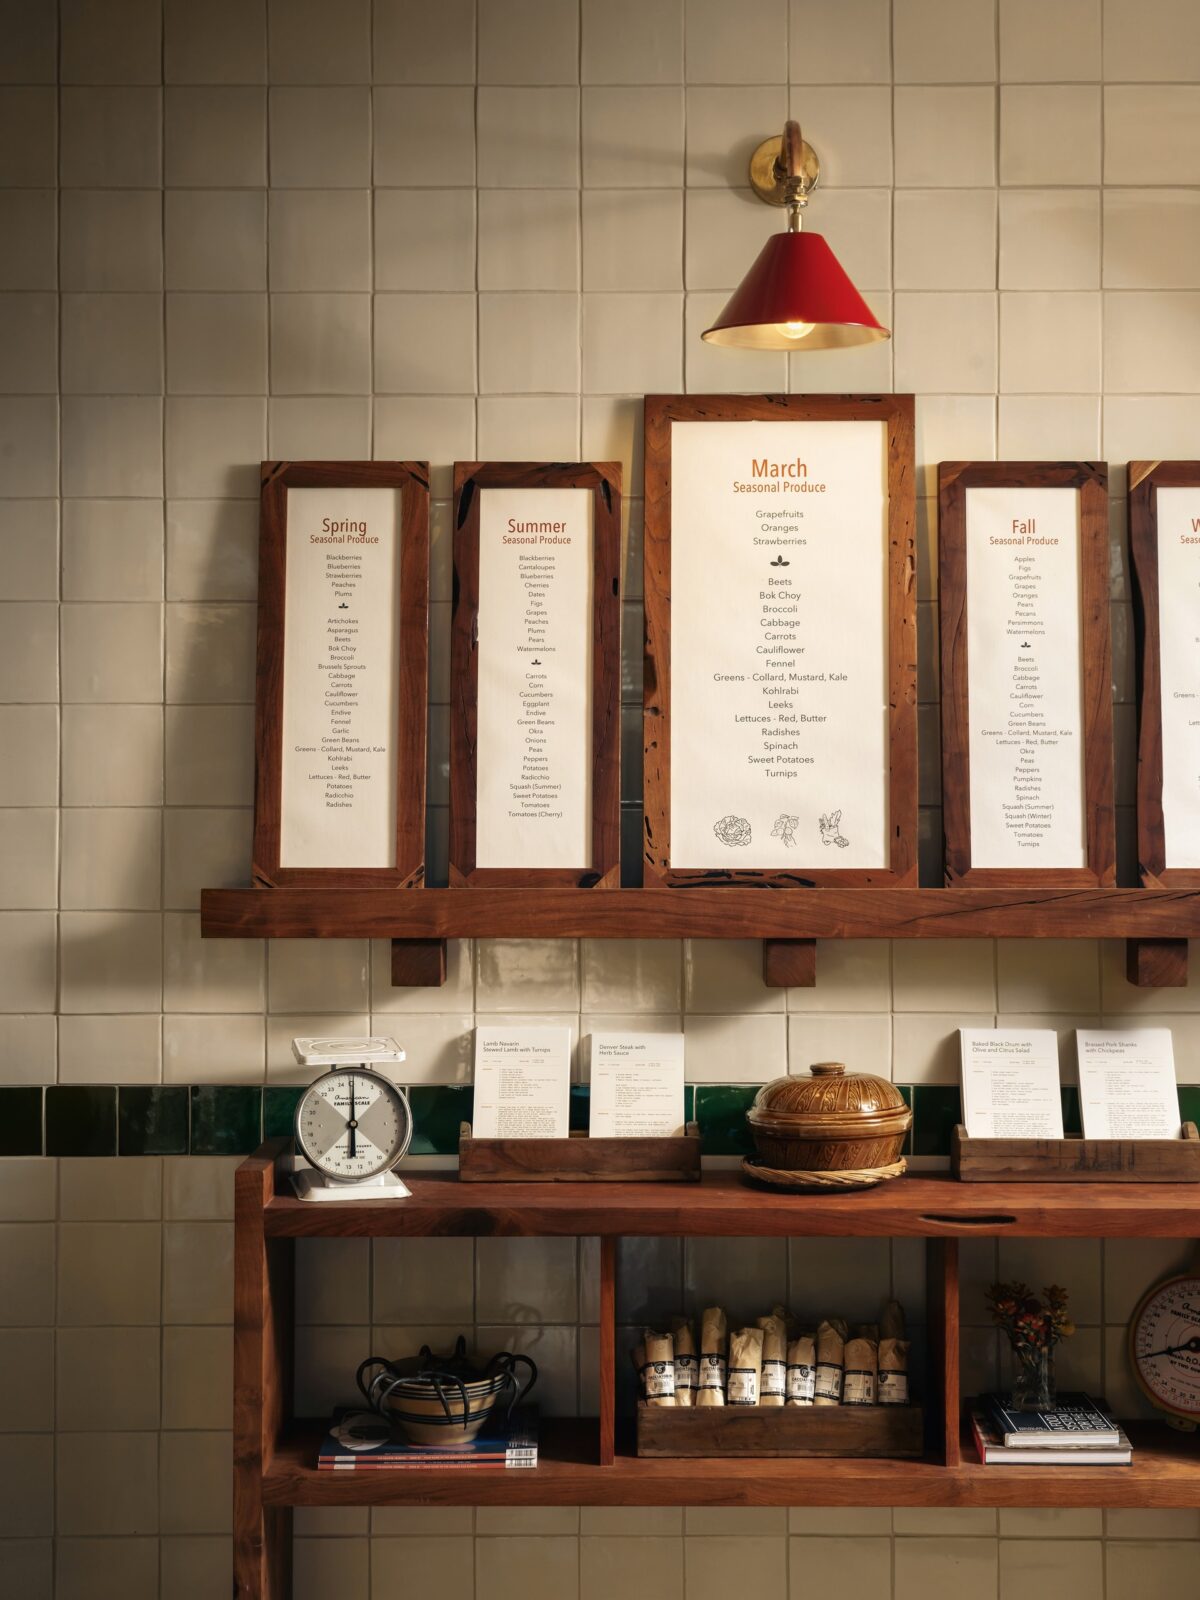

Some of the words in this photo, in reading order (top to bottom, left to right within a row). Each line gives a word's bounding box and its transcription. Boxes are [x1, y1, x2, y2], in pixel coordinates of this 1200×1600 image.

[752, 458, 807, 478] March
[733, 481, 780, 493] Seasonal
[783, 481, 826, 493] Produce
[755, 509, 804, 520] Grapefruits
[322, 517, 367, 537] Spring
[508, 518, 567, 533] Summer
[761, 523, 799, 534] Oranges
[1012, 519, 1035, 534] Fall
[310, 534, 345, 544] Seasonal
[347, 534, 379, 544] Produce
[502, 535, 537, 544] Seasonal
[539, 535, 571, 544] Produce
[753, 537, 807, 545] Strawberries
[990, 536, 1025, 545] Seasonal
[1027, 536, 1059, 545] Produce
[768, 577, 792, 586] Beets
[759, 591, 776, 600] Bok
[778, 591, 801, 601] Choy
[762, 605, 798, 613] Broccoli
[760, 618, 801, 629] Cabbage
[764, 632, 797, 641] Carrots
[755, 645, 805, 654] Cauliflower
[766, 659, 795, 668] Fennel
[713, 673, 745, 682] Greens
[752, 673, 787, 682] Collard,
[789, 673, 827, 682] Mustard,
[829, 673, 848, 681] Kale
[762, 686, 799, 695] Kohlrabi
[768, 700, 794, 709] Leeks
[735, 714, 771, 723] Lettuces
[778, 714, 798, 723] Red,
[800, 714, 827, 723] Butter
[761, 728, 800, 736] Radishes
[763, 741, 798, 752] Spinach
[748, 755, 775, 764] Sweet
[776, 755, 815, 764] Potatoes
[764, 769, 798, 779] Turnips
